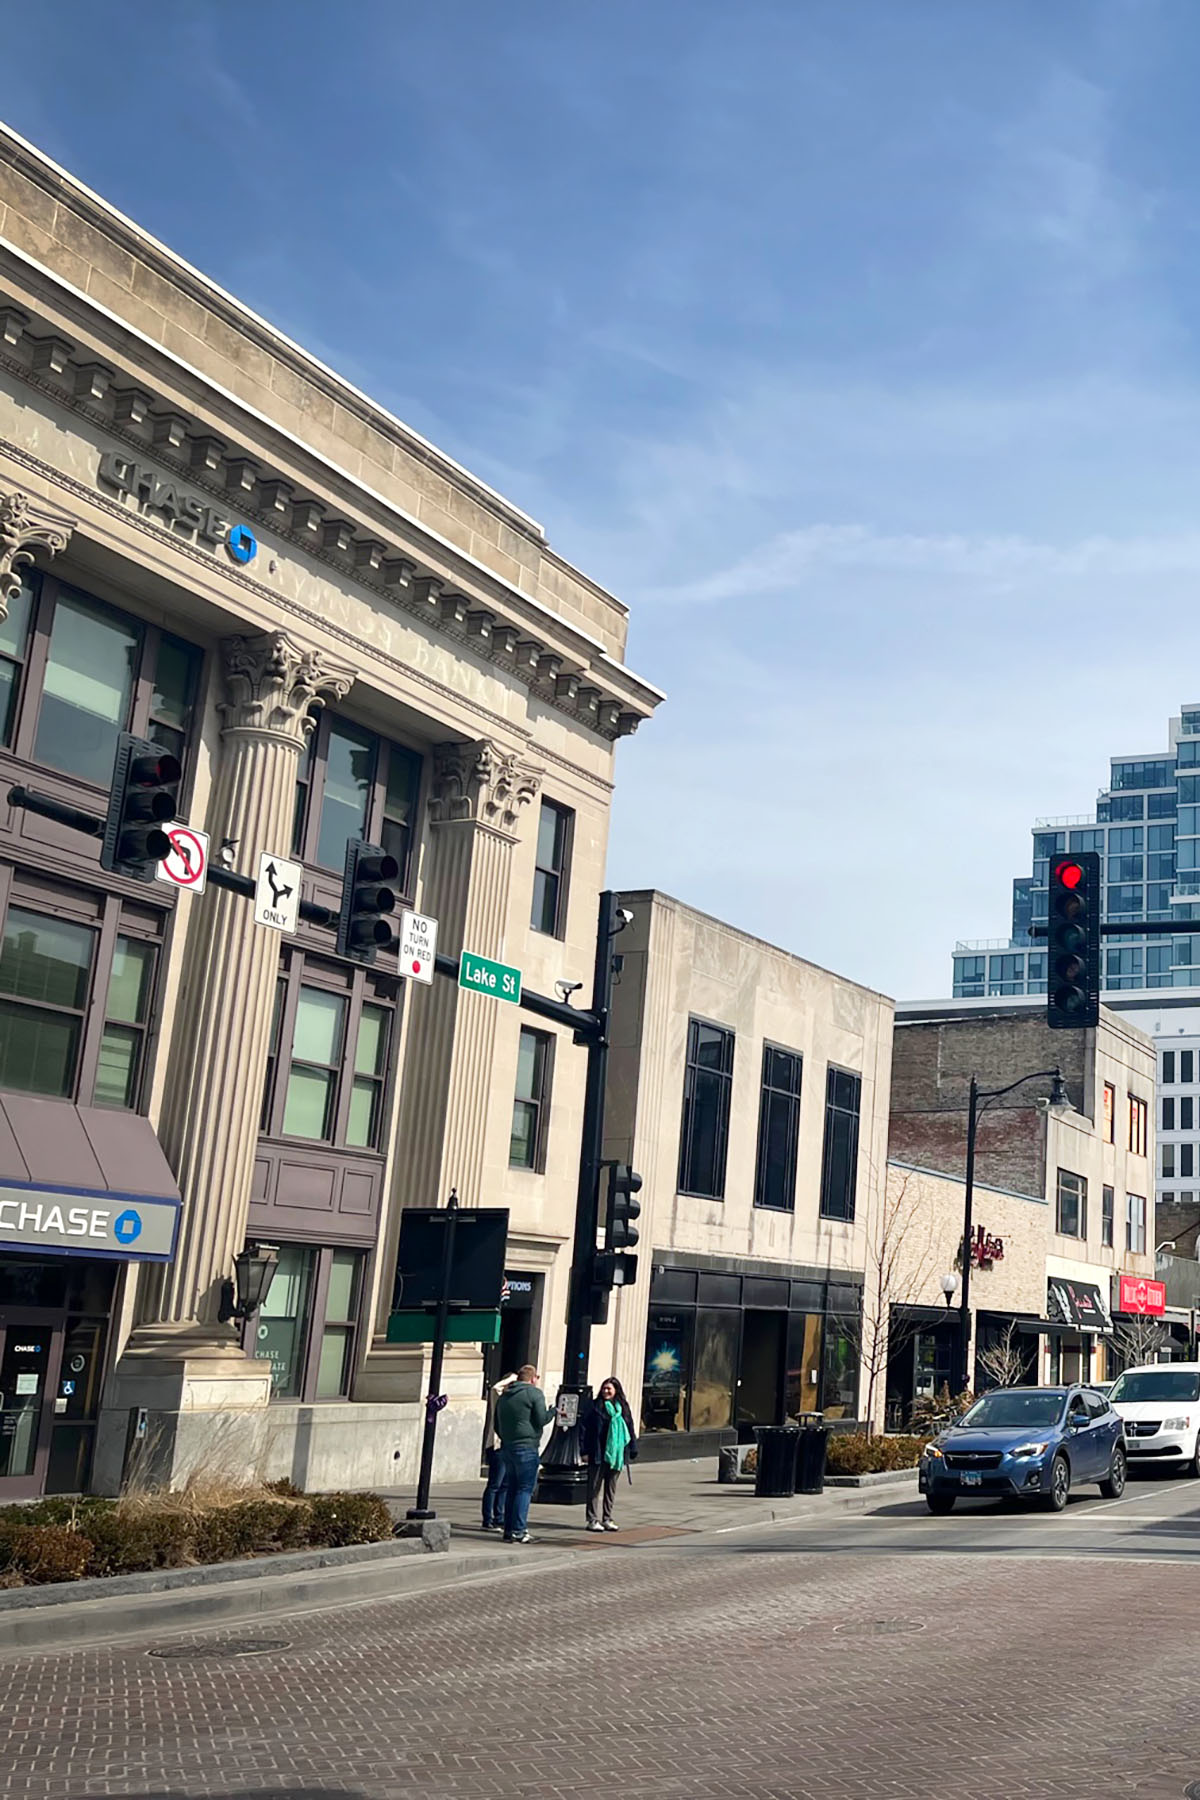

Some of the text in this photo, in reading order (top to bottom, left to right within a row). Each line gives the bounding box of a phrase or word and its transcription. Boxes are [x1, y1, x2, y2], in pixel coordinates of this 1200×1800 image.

[98, 453, 230, 544] CHASE
[262, 909, 288, 926] ONLY
[412, 918, 428, 934] NO
[409, 932, 429, 947] TURN
[403, 944, 432, 962] ON RED
[465, 961, 515, 994] Lake St
[0, 1200, 111, 1238] CHASE
[255, 1350, 279, 1359] CHASE
